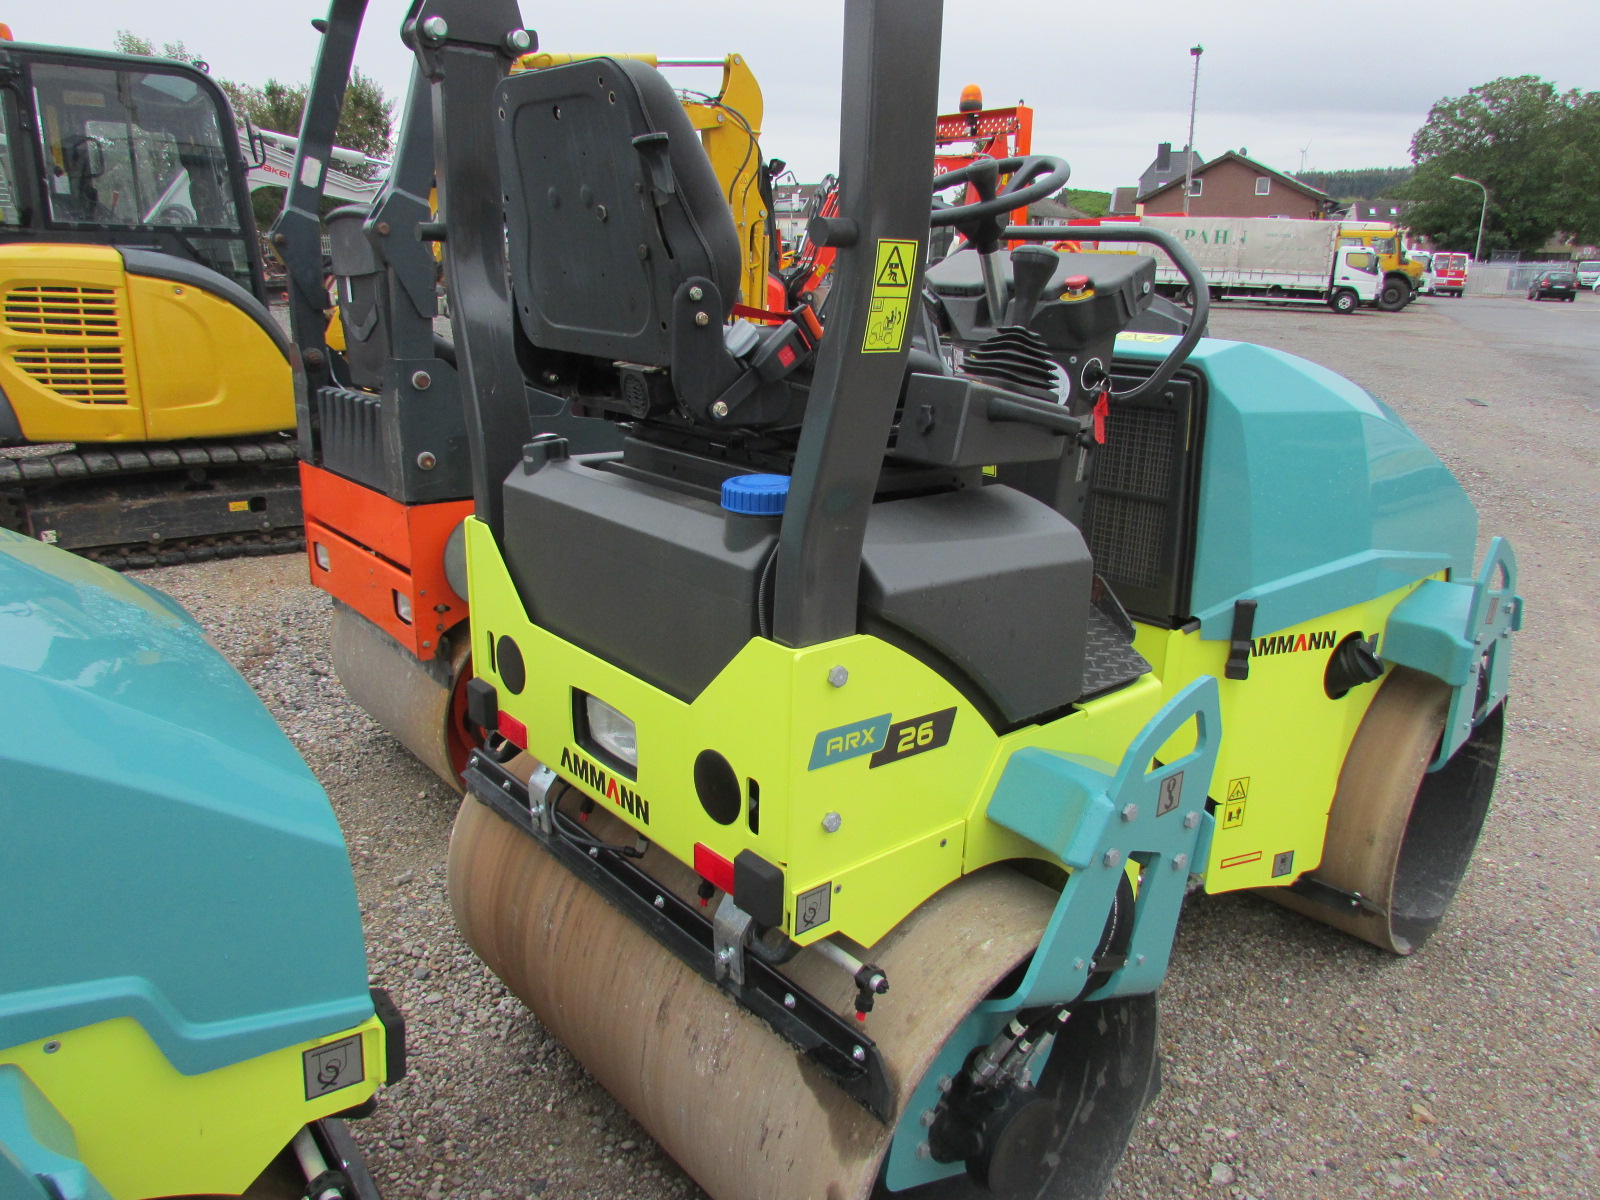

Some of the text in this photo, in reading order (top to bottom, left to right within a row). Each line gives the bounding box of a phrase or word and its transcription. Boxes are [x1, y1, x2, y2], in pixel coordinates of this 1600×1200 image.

[826, 721, 934, 757] ARX 26
[560, 746, 649, 826] AMMANN
